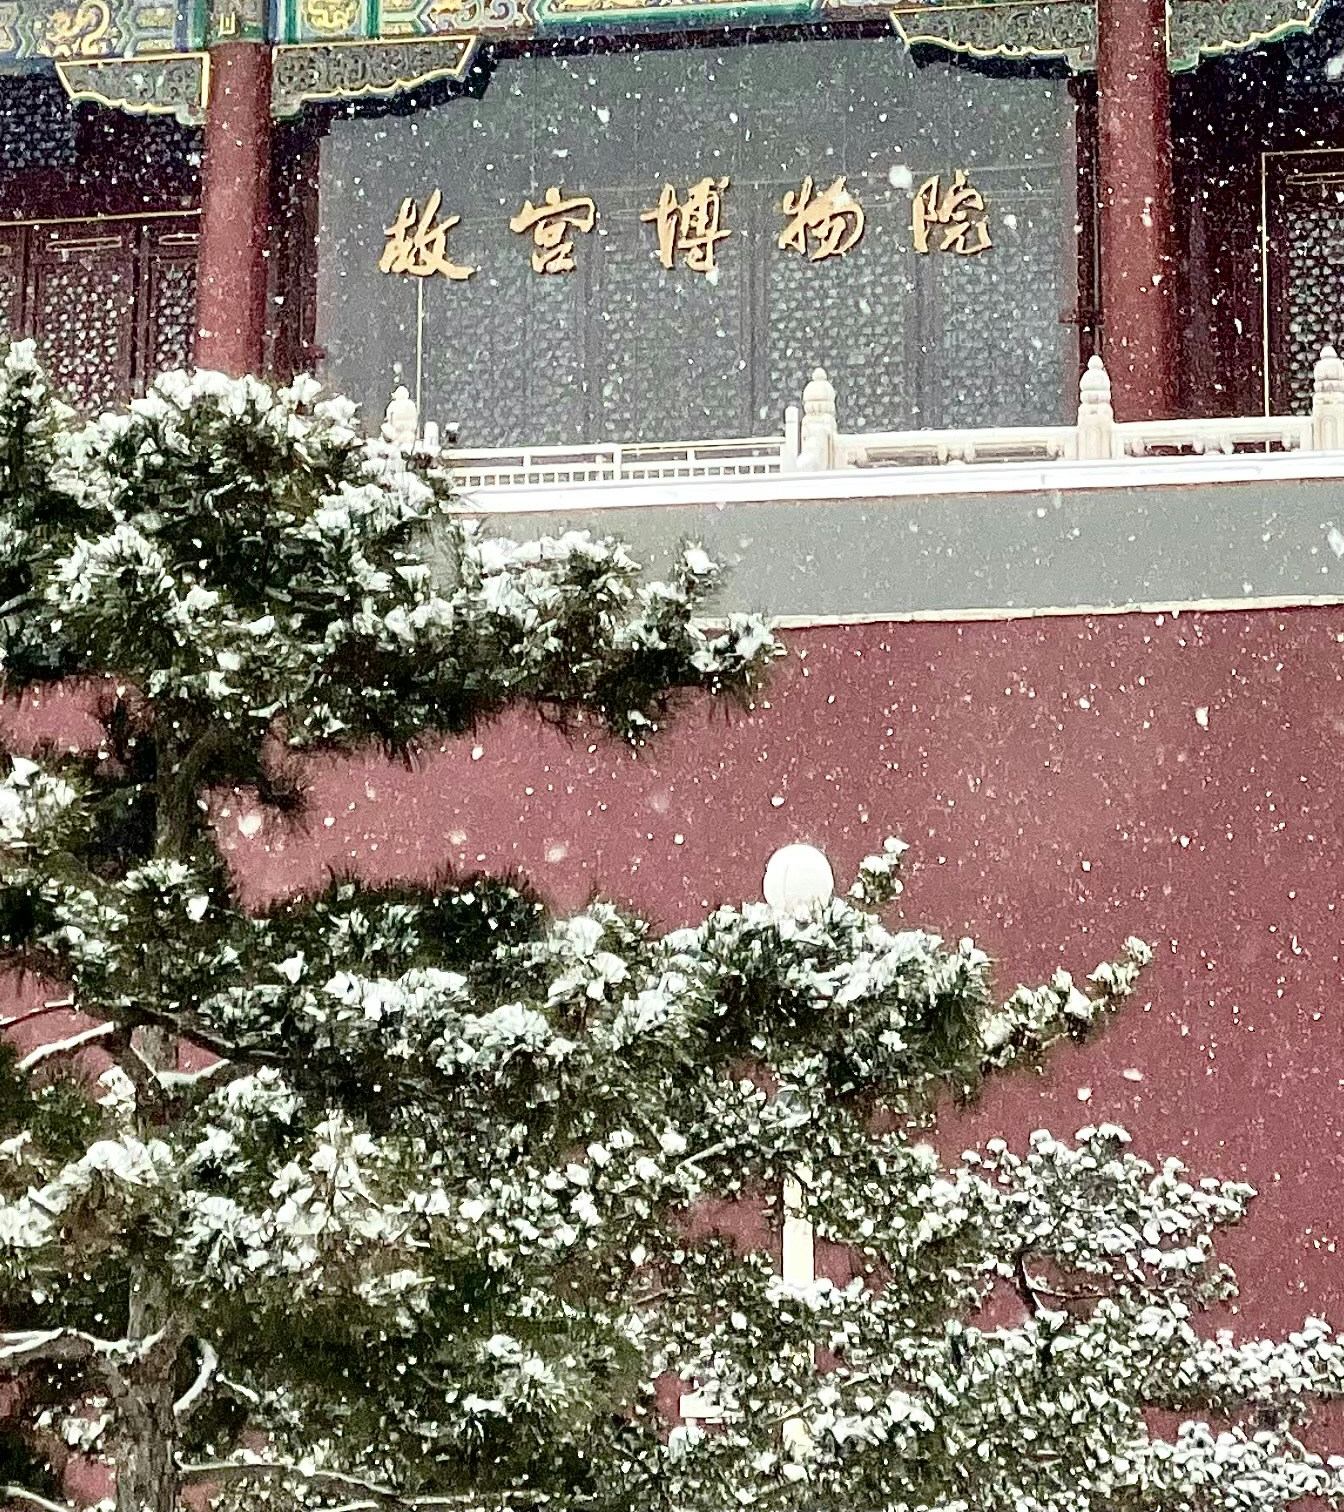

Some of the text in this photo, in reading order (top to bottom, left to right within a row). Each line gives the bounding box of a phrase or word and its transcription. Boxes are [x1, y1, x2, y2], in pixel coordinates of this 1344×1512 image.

[378, 169, 993, 280] 故宫博物院
